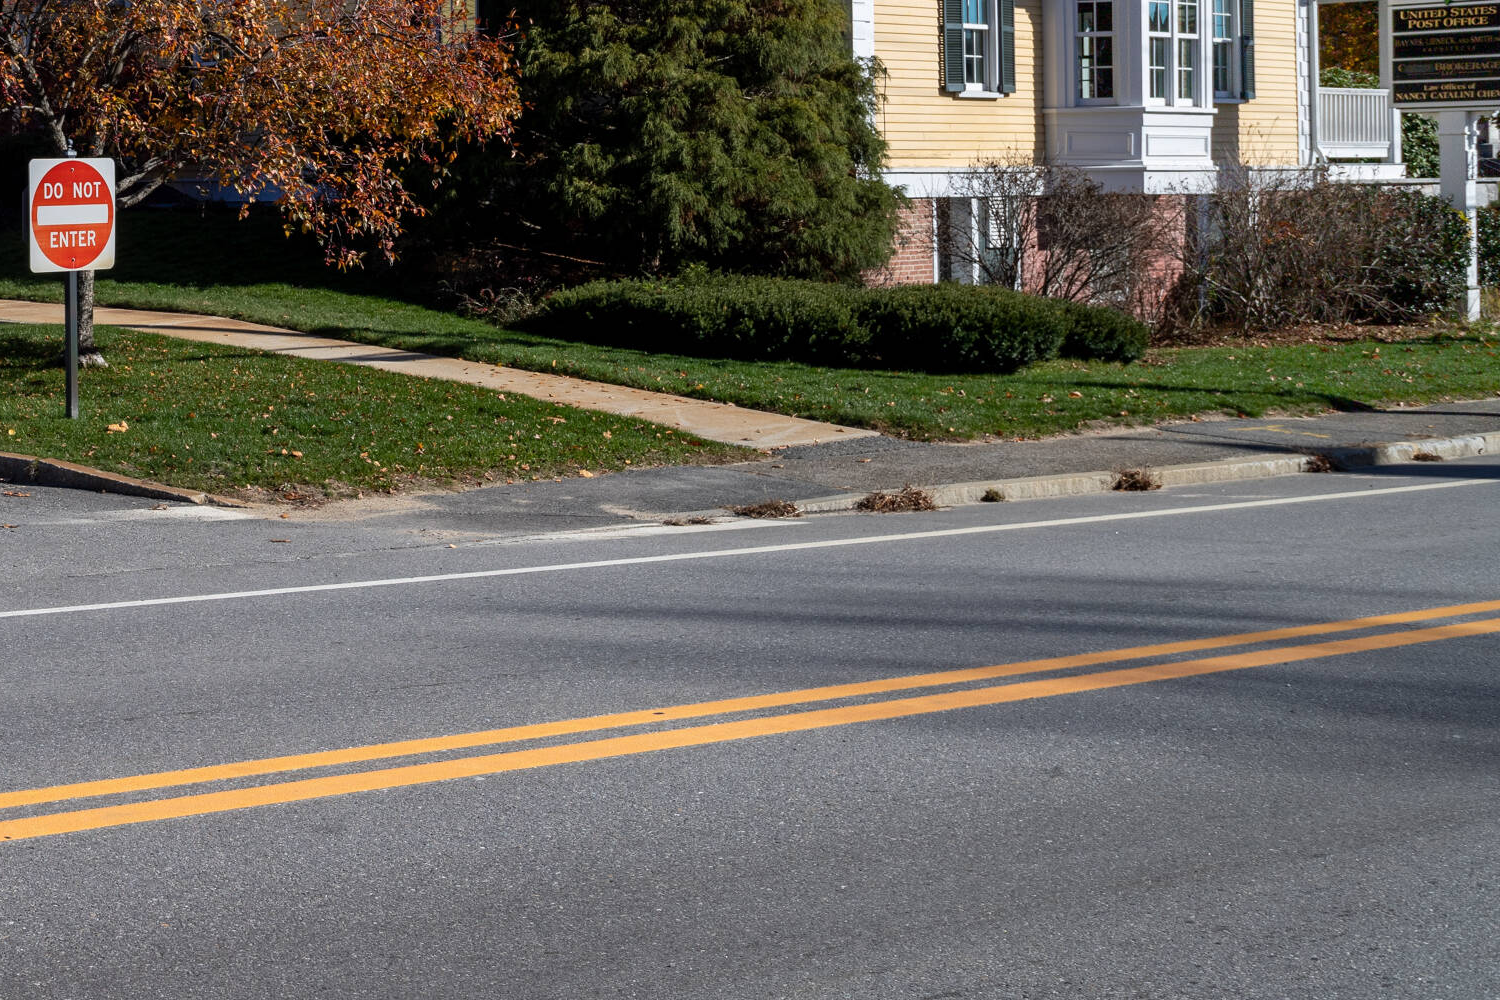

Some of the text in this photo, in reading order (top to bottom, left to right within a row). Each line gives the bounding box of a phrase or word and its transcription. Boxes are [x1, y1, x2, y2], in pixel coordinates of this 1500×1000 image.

[1400, 6, 1497, 20] UNITED STATES
[1408, 16, 1489, 29] POST OFFICE
[1395, 92, 1427, 101] NANCY
[1430, 90, 1475, 99] CATALINI
[43, 181, 101, 199] DO NOT
[50, 230, 96, 248] ENTER
